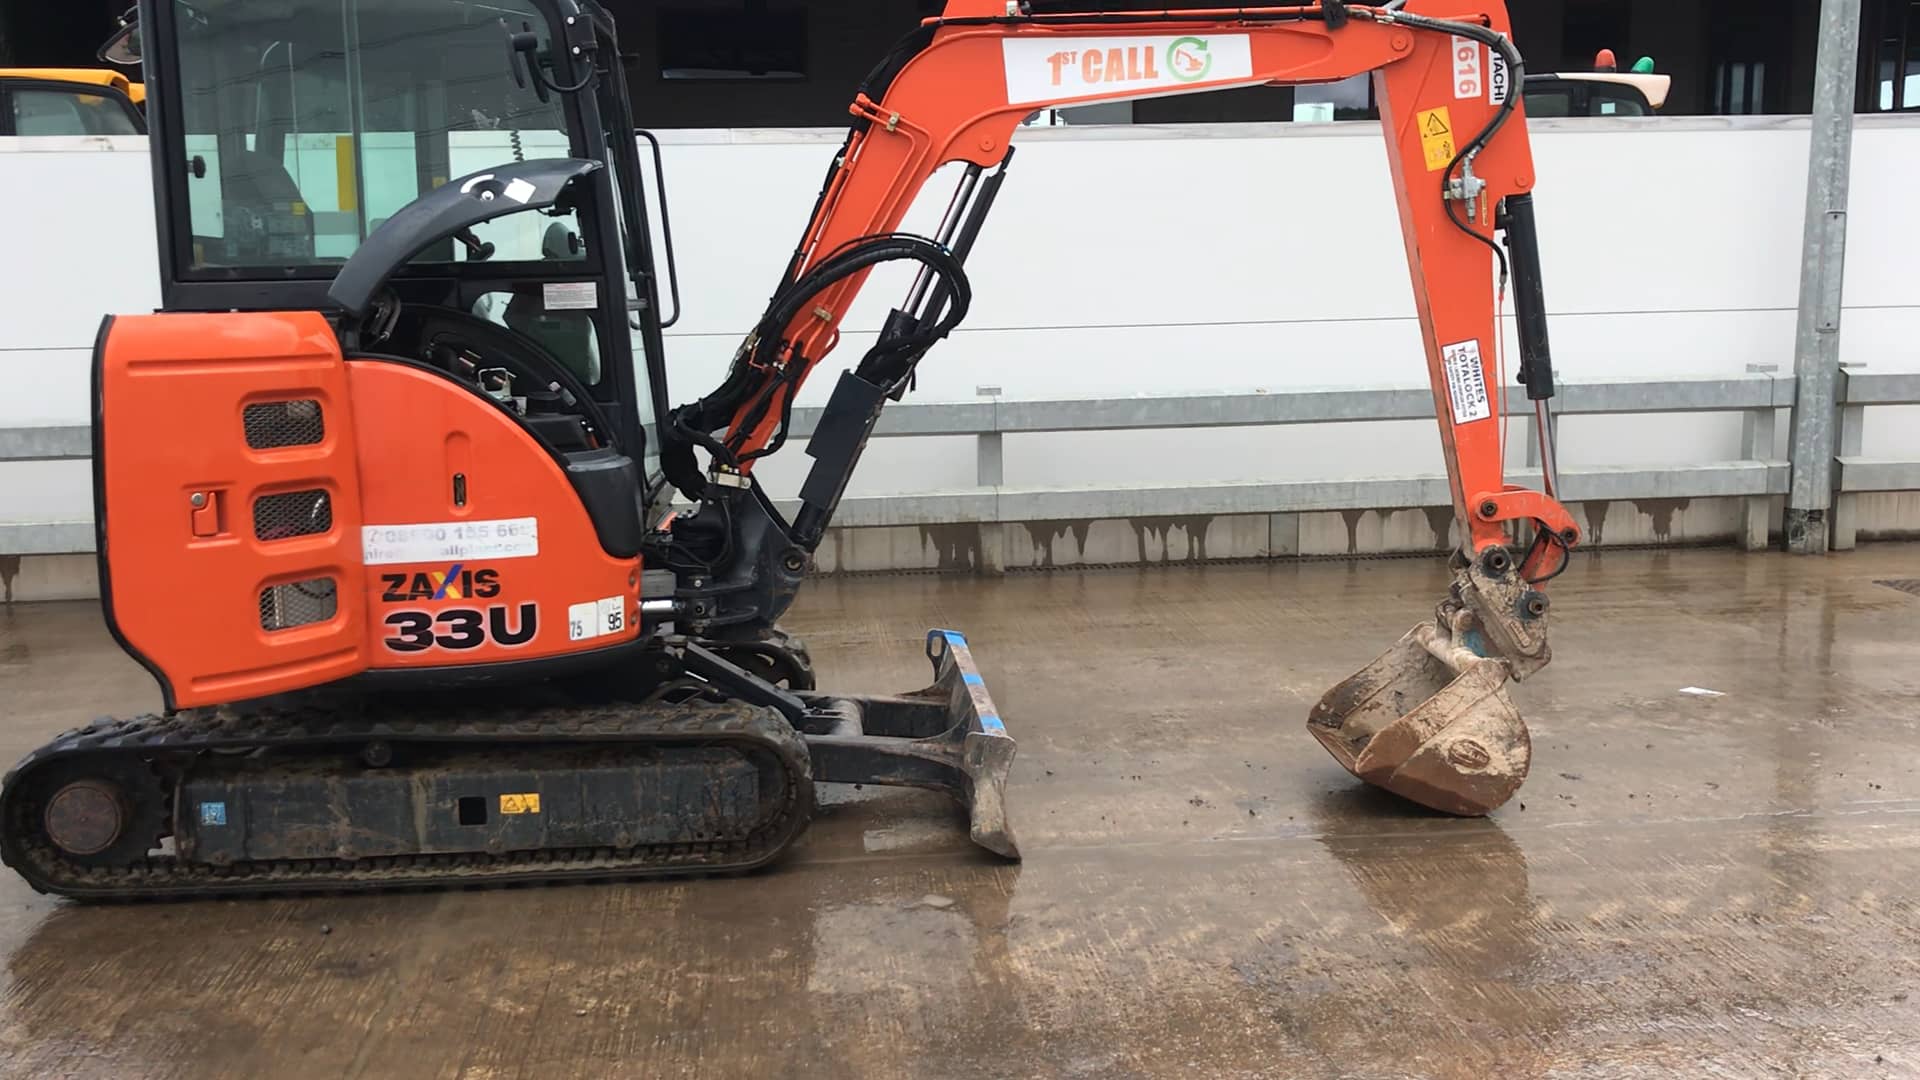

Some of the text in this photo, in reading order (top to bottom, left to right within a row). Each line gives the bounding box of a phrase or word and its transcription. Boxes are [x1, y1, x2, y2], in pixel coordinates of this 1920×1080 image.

[1047, 46, 1159, 86] 1ST CALL
[1493, 52, 1505, 101] TACHI
[1457, 346, 1477, 409] TOTALOCK
[1470, 356, 1486, 404] WHITES
[381, 564, 501, 602] ZAXIS
[383, 603, 537, 652] 33U
[607, 611, 622, 632] 95
